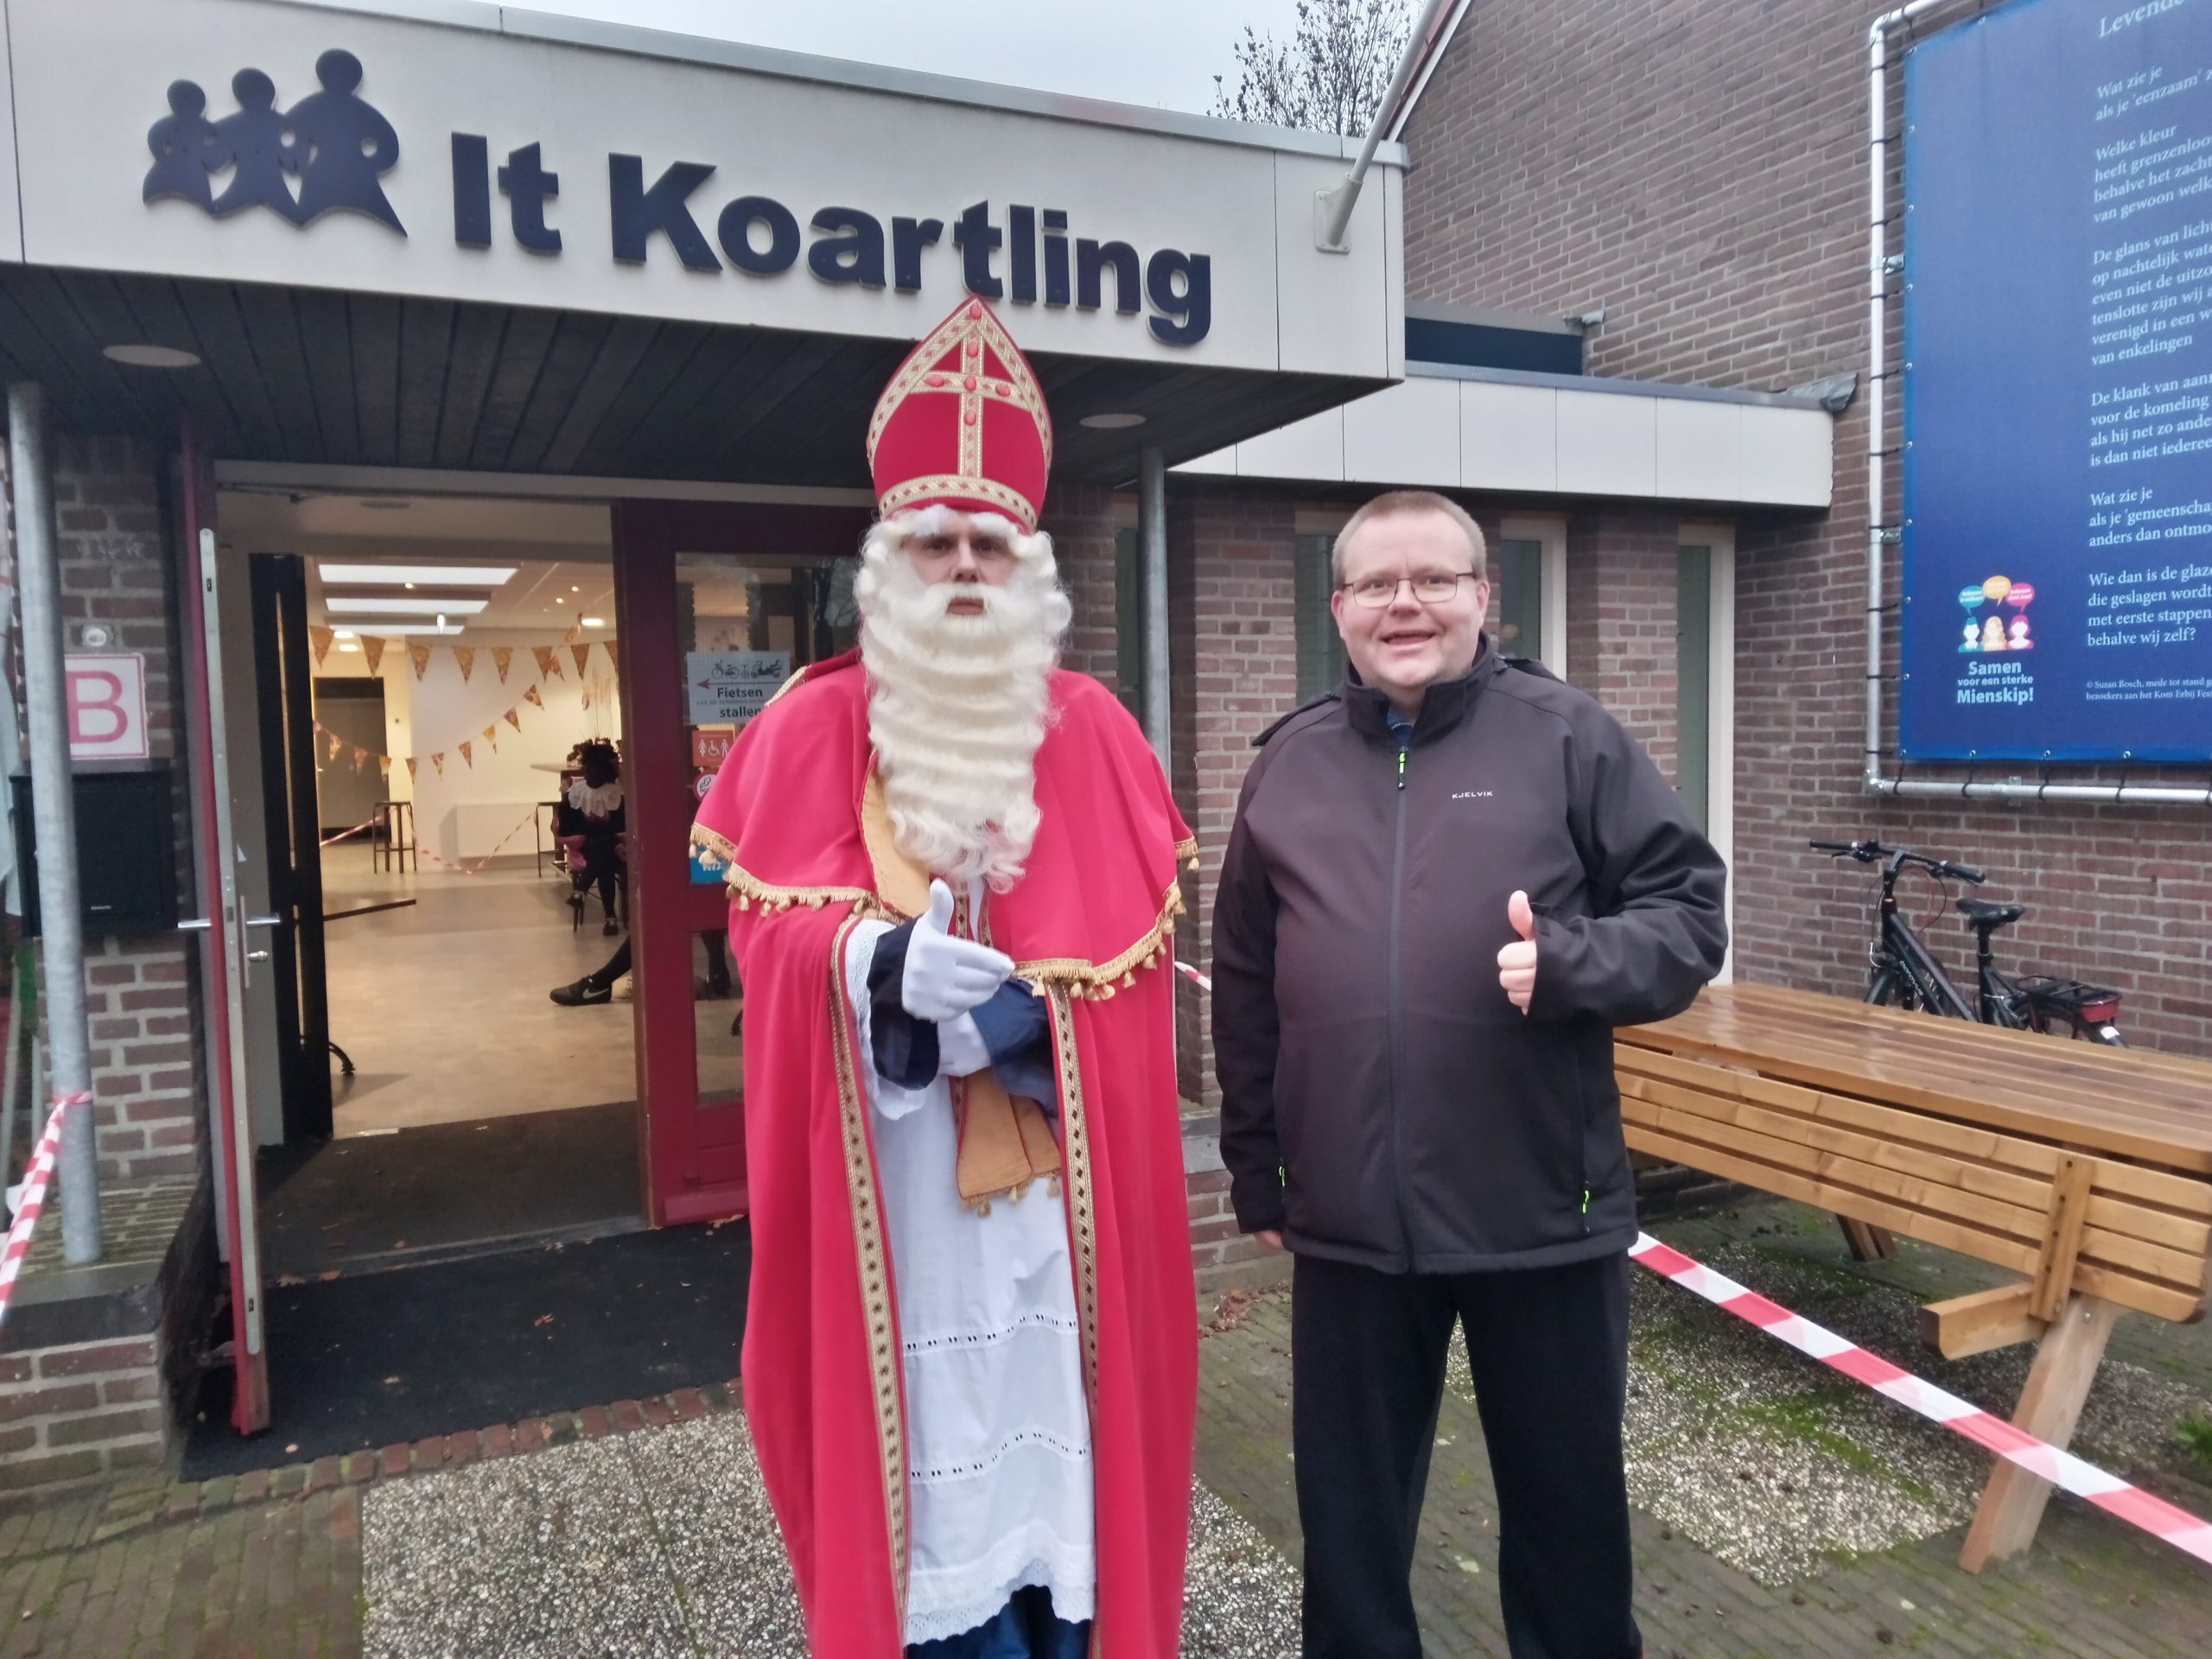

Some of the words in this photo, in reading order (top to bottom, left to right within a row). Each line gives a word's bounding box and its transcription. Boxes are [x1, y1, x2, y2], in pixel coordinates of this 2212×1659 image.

[2097, 80, 2122, 99] Wat
[2127, 72, 2146, 88] zie
[2149, 66, 2163, 85] je
[2095, 104, 2113, 120] als
[2117, 99, 2129, 118] je
[2096, 138, 2136, 161] Welke
[2139, 125, 2177, 147] kleur
[2095, 159, 2126, 182] heeft
[2131, 136, 2212, 175] grenzenloo
[2094, 179, 2145, 202] behalve
[2149, 169, 2171, 186] het
[2094, 208, 2117, 222] van
[2120, 191, 2174, 219] gewoon
[451, 132, 563, 254] It
[607, 151, 1212, 347] Koartling
[2093, 250, 2112, 264] De
[2115, 239, 2150, 262] glans
[2154, 232, 2178, 246] van
[2183, 219, 2212, 239] lich
[2093, 271, 2109, 286] op
[2113, 250, 2179, 279] nachtelijk
[2093, 289, 2122, 304] even
[2126, 279, 2152, 296] niet
[2156, 274, 2172, 289] de
[2093, 302, 2148, 325] tenslotte
[2152, 296, 2177, 313] zijn
[2182, 286, 2203, 304] wij
[2093, 320, 2148, 345] verenigd
[2153, 318, 2166, 332] in
[2170, 313, 2195, 327] een
[2092, 353, 2114, 365] van
[2119, 334, 2192, 359] enkelingen
[2091, 392, 2110, 406] De
[2113, 382, 2151, 402] klank
[2154, 380, 2178, 393] van
[2091, 411, 2120, 426] voor
[2124, 405, 2140, 420] de
[2144, 396, 2209, 417] komeling
[2091, 432, 2107, 447] als
[2112, 428, 2128, 445] hij
[2133, 425, 2153, 440] net
[2157, 423, 2173, 435] zo
[2091, 454, 2101, 467] is
[2104, 450, 2128, 464] dan
[2133, 445, 2158, 460] niet
[2091, 492, 2115, 505] Wat
[2119, 489, 2138, 503] zie
[2140, 486, 2153, 504] je
[2089, 512, 2107, 527] als
[2109, 512, 2121, 528] je
[2125, 499, 2212, 526] 'gemeenscha
[2089, 531, 2133, 546] anders
[2136, 527, 2160, 542] dan
[2164, 524, 2212, 538] ontmo
[2089, 572, 2115, 587] Wie
[2118, 570, 2142, 584] dan
[2146, 569, 2158, 582] is
[2161, 566, 2177, 580] de
[2088, 593, 2107, 607] die
[2111, 589, 2167, 608] geslagen
[2171, 583, 2212, 600] wordt
[2088, 613, 2112, 626] met
[2116, 611, 2154, 624] eerste
[2158, 608, 2212, 624] stappen
[2088, 631, 2137, 646] behalve
[2140, 630, 2160, 646] wij
[2164, 627, 2196, 642] zelf?
[1957, 677, 1980, 687] voor
[1981, 677, 1999, 686] een
[2001, 674, 2034, 685] sterke
[1968, 661, 2021, 676] Samen
[717, 687, 763, 699] Fietsen
[1957, 687, 2034, 705] Mienskip!
[66, 671, 128, 744] B
[1452, 791, 1493, 799] KJELVIK
